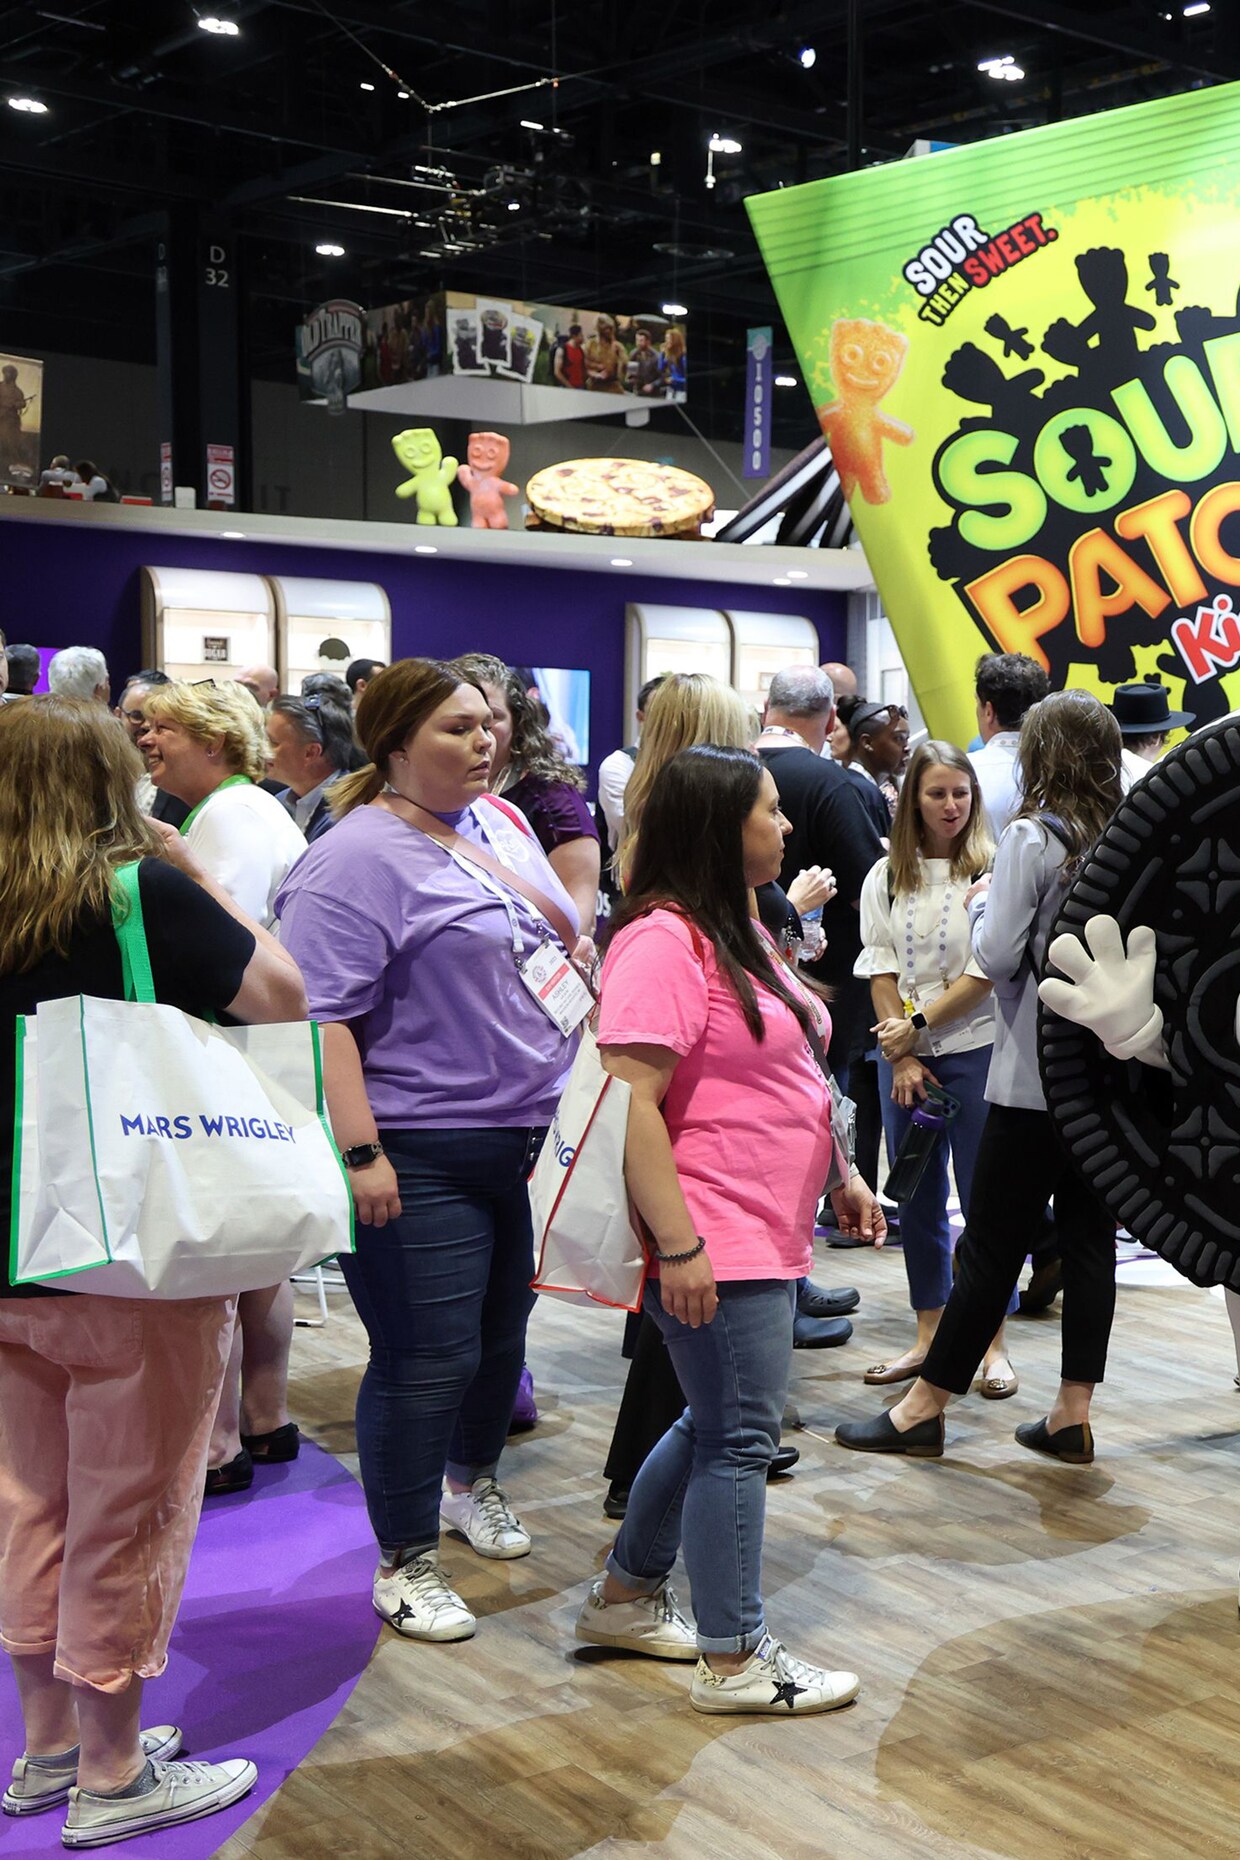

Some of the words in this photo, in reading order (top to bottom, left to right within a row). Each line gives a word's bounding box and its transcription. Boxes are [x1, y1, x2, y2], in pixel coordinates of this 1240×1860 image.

[205, 268, 229, 287] 32
[210, 246, 226, 263] D
[905, 215, 989, 294] SOUR
[920, 271, 970, 325] THEN
[963, 214, 1057, 286] SWEET.
[751, 363, 764, 471] 10500
[119, 1112, 193, 1140] MARS
[198, 1114, 296, 1145] WRIGLEY
